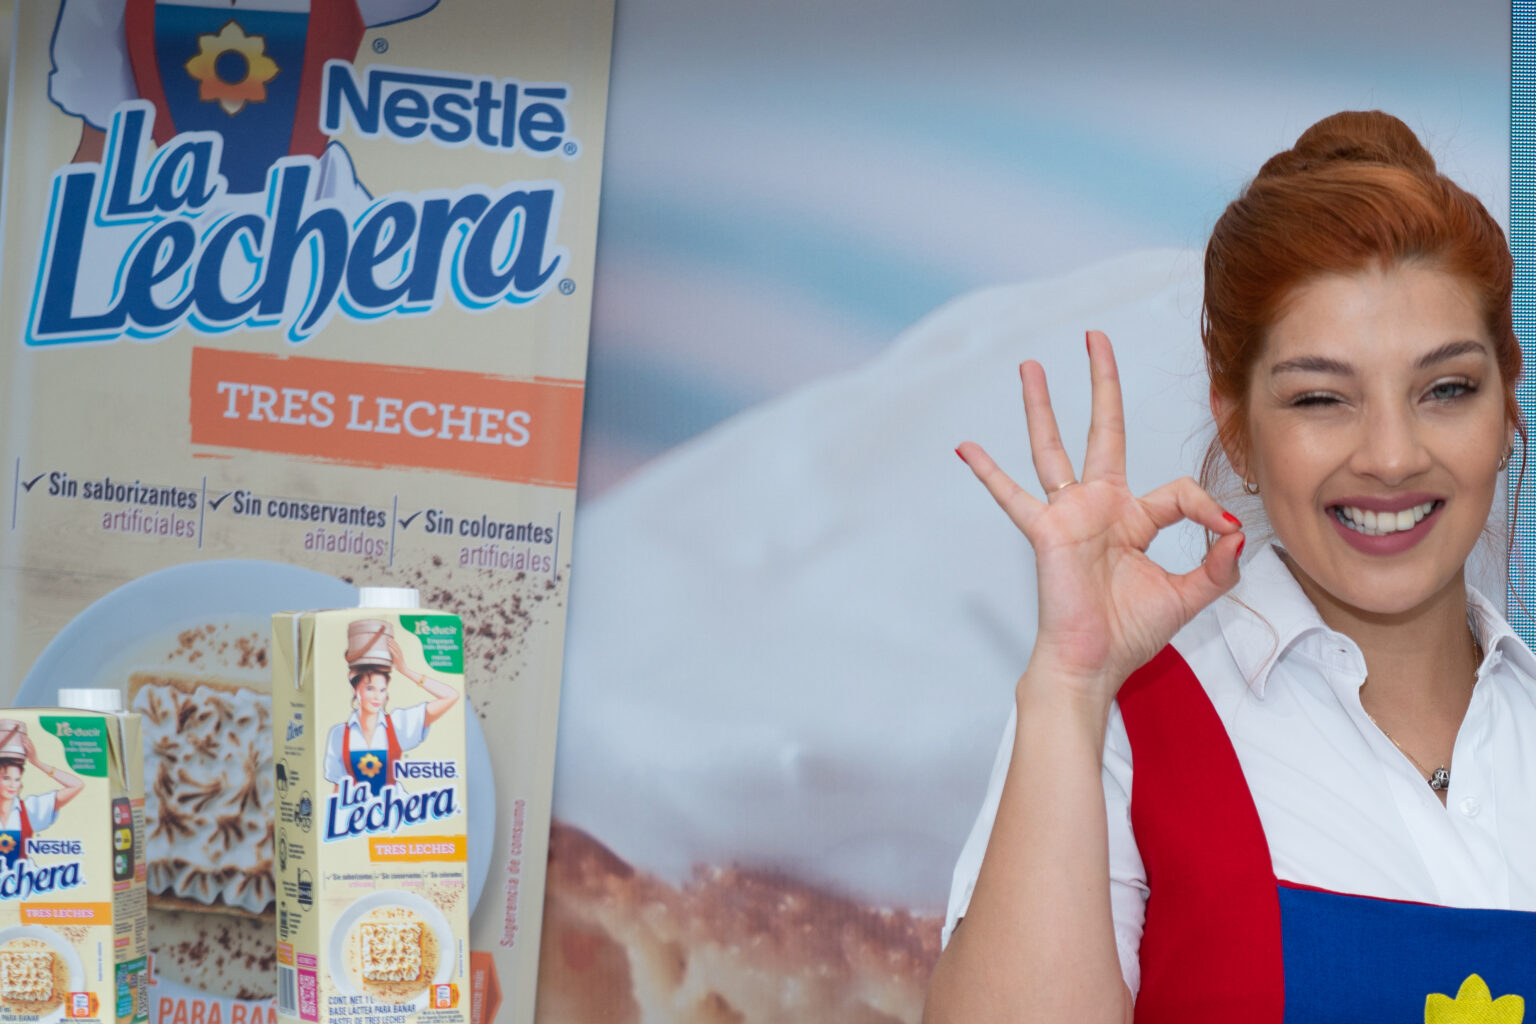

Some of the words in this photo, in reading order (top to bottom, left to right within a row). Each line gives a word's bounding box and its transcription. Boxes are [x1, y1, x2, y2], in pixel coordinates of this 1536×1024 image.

[103, 110, 221, 217] La
[33, 166, 561, 338] Lechera
[217, 381, 335, 428] TRES
[345, 394, 531, 447] LECHES
[48, 471, 77, 498] Sin
[83, 477, 197, 509] saborizantes
[102, 508, 196, 539] artificiales
[233, 490, 261, 516] Sin
[267, 499, 386, 529] conservantes
[425, 509, 453, 535] Sin
[459, 514, 554, 545] colorantes
[304, 528, 385, 557] añadidos
[459, 545, 551, 574] artificiales
[341, 779, 369, 808] La
[374, 844, 407, 856] TRES
[408, 843, 456, 855] LECHES
[0, 862, 80, 899] chera
